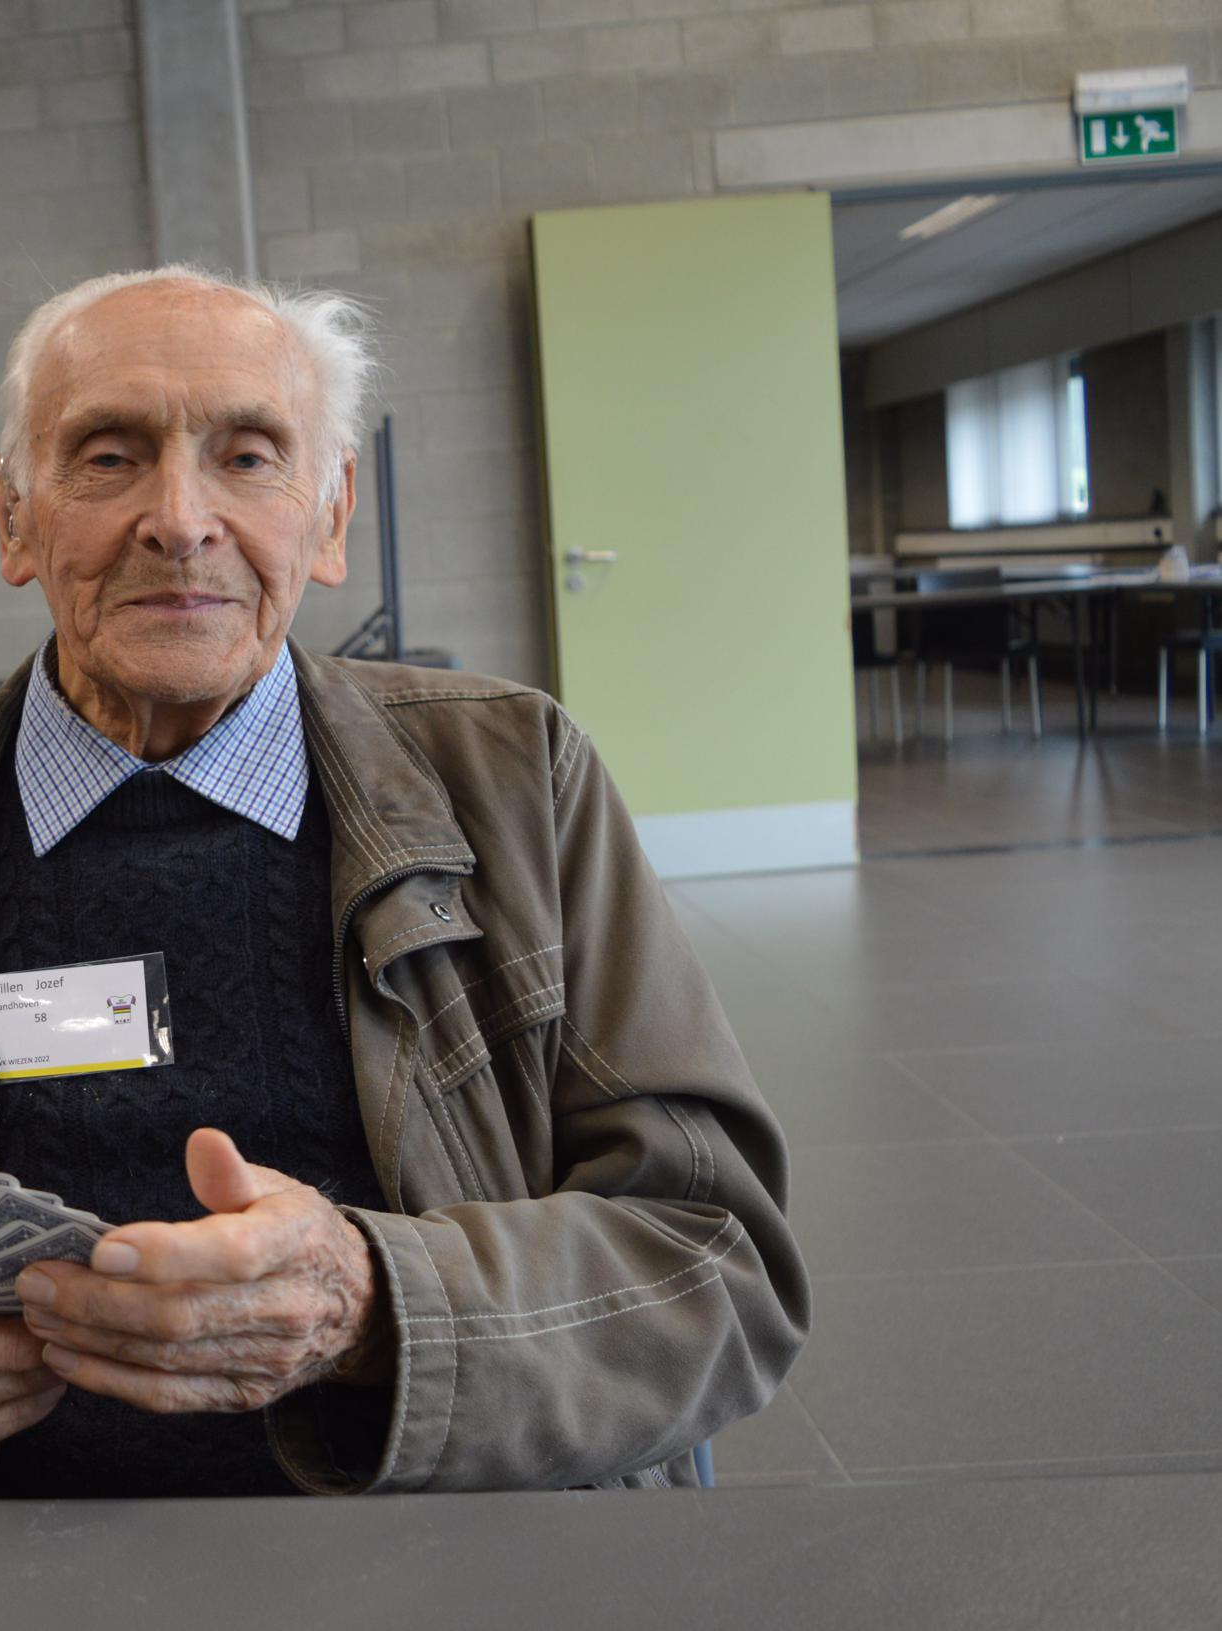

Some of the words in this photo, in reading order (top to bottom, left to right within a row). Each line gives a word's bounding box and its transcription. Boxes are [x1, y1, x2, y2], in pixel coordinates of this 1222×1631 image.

[35, 976, 64, 990] Jozef
[34, 1012, 47, 1023] 58
[34, 1055, 50, 1063] 2022
